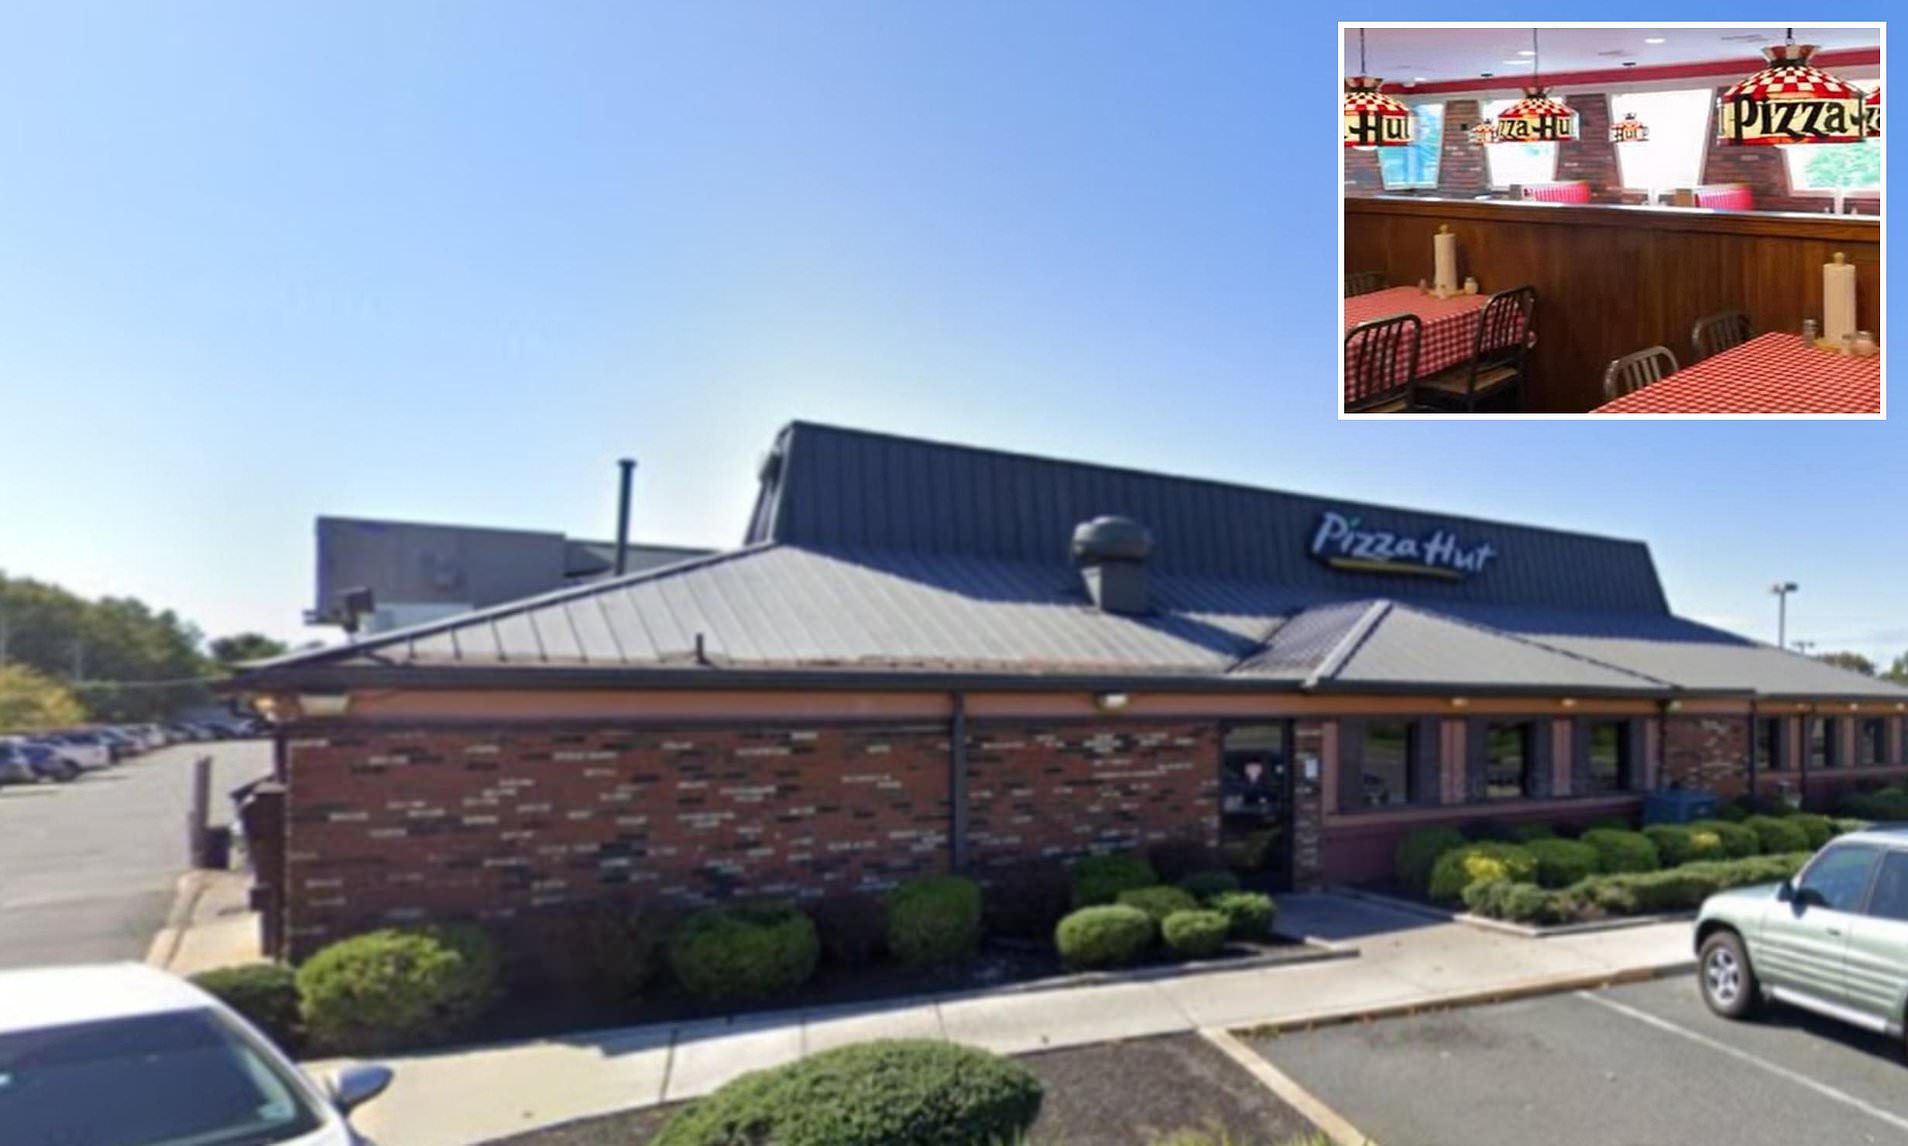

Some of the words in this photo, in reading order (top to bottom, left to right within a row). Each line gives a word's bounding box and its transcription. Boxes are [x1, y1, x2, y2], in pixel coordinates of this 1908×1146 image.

[1734, 94, 1848, 143] Pizza
[1312, 511, 1419, 560] Pizza
[1419, 529, 1496, 572] Hut
